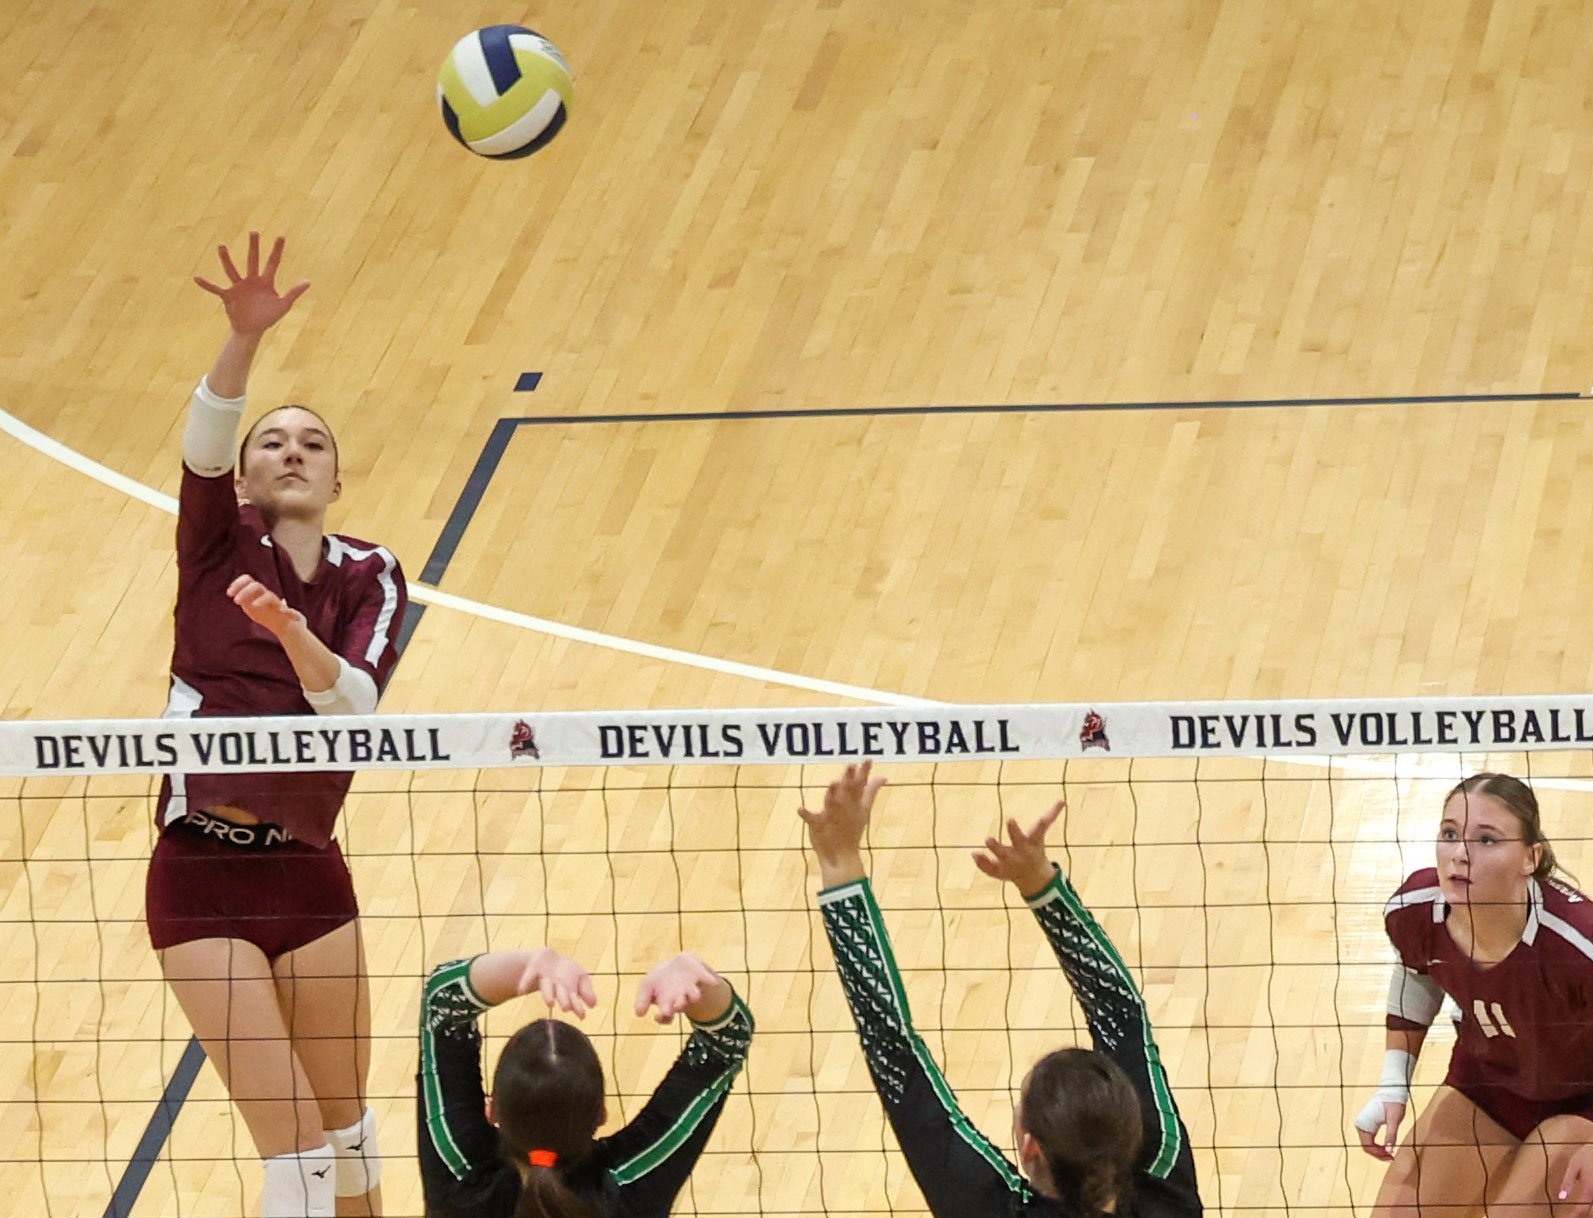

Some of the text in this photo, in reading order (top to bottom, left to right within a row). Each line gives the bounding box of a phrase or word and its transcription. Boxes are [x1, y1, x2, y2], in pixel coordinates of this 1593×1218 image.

[34, 728, 450, 769] DEVILS VOLLEYBALL
[598, 719, 1020, 759] DEVILS VOLLEYBALL
[1169, 713, 1317, 749] DEVILS
[183, 811, 256, 845] PRO
[1473, 999, 1517, 1039] 11
